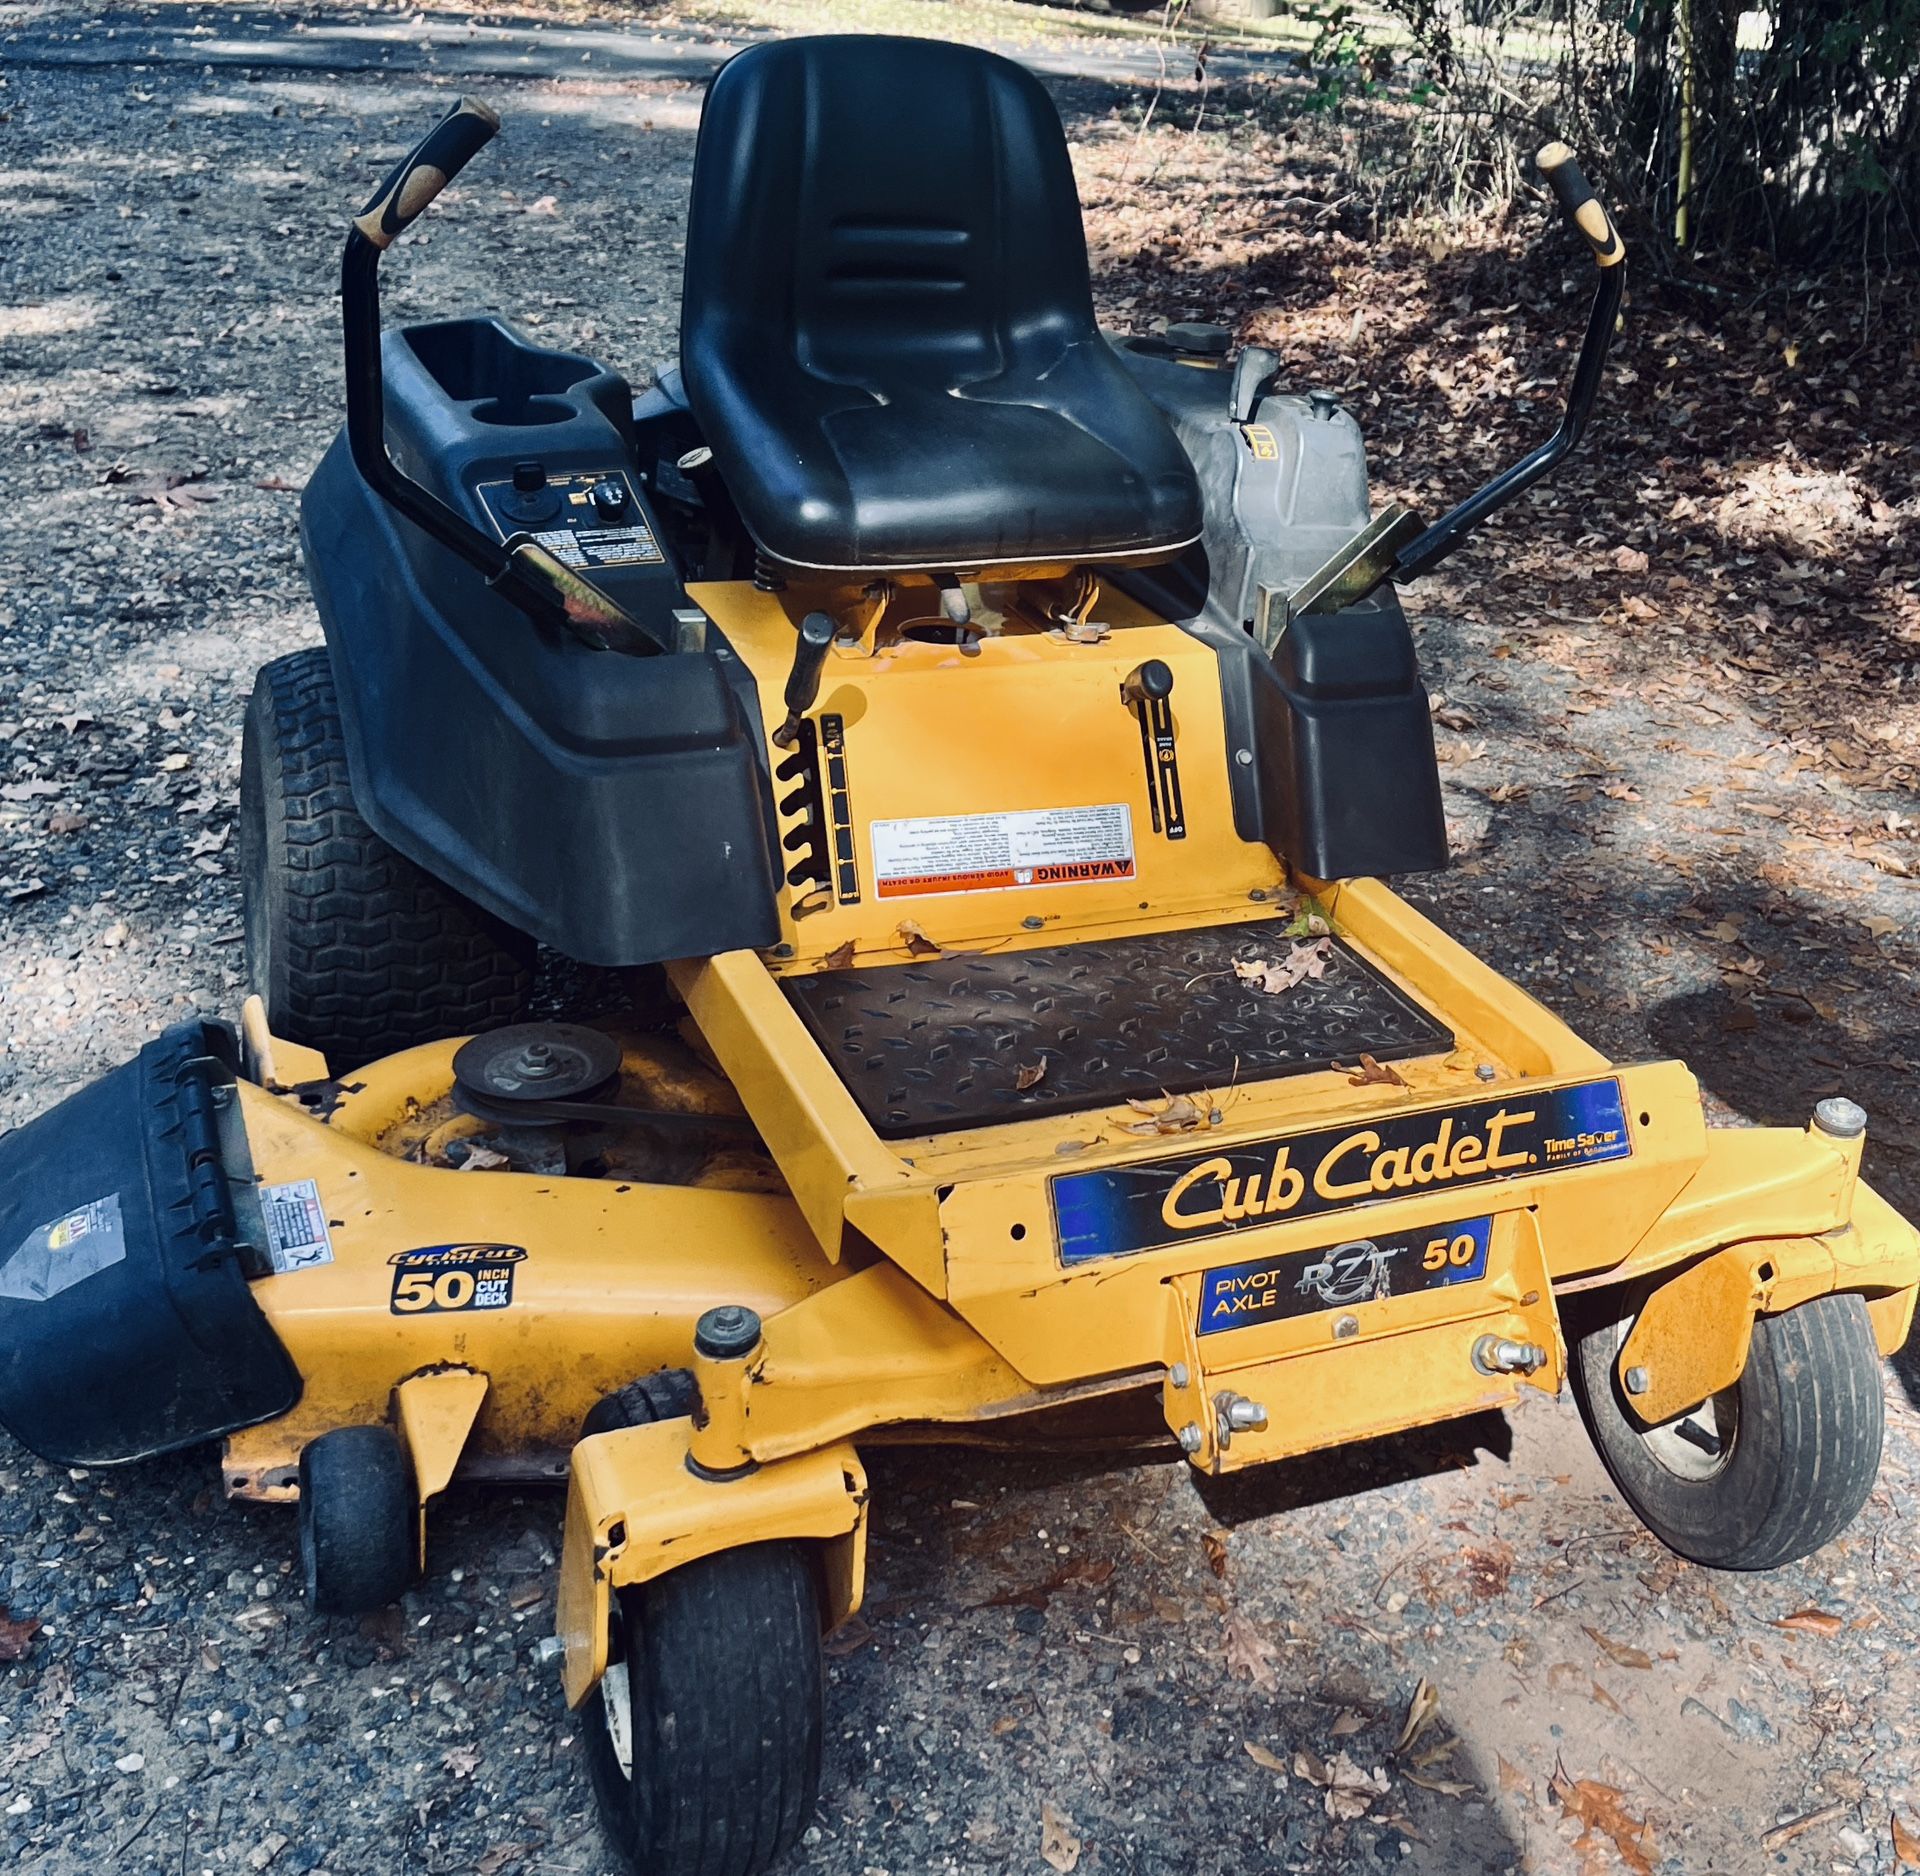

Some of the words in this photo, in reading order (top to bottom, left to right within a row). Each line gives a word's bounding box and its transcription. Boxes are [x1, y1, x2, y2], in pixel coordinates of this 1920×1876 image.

[952, 872, 985, 881] SERIOUS
[987, 870, 1009, 878] AVOID
[1038, 862, 1114, 879] WARNING
[882, 878, 908, 887] DEATH
[923, 875, 950, 883] INJURY
[1544, 1139, 1575, 1153] Time
[1578, 1131, 1618, 1147] Saver
[1162, 1147, 1304, 1229] Cub
[1422, 1234, 1475, 1270] 50
[478, 1268, 509, 1280] INCH
[476, 1280, 508, 1293] CUT
[1216, 1270, 1280, 1295] PIVOT
[394, 1271, 475, 1311] 50
[475, 1291, 507, 1306] DECK
[1212, 1290, 1277, 1316] AXLE
